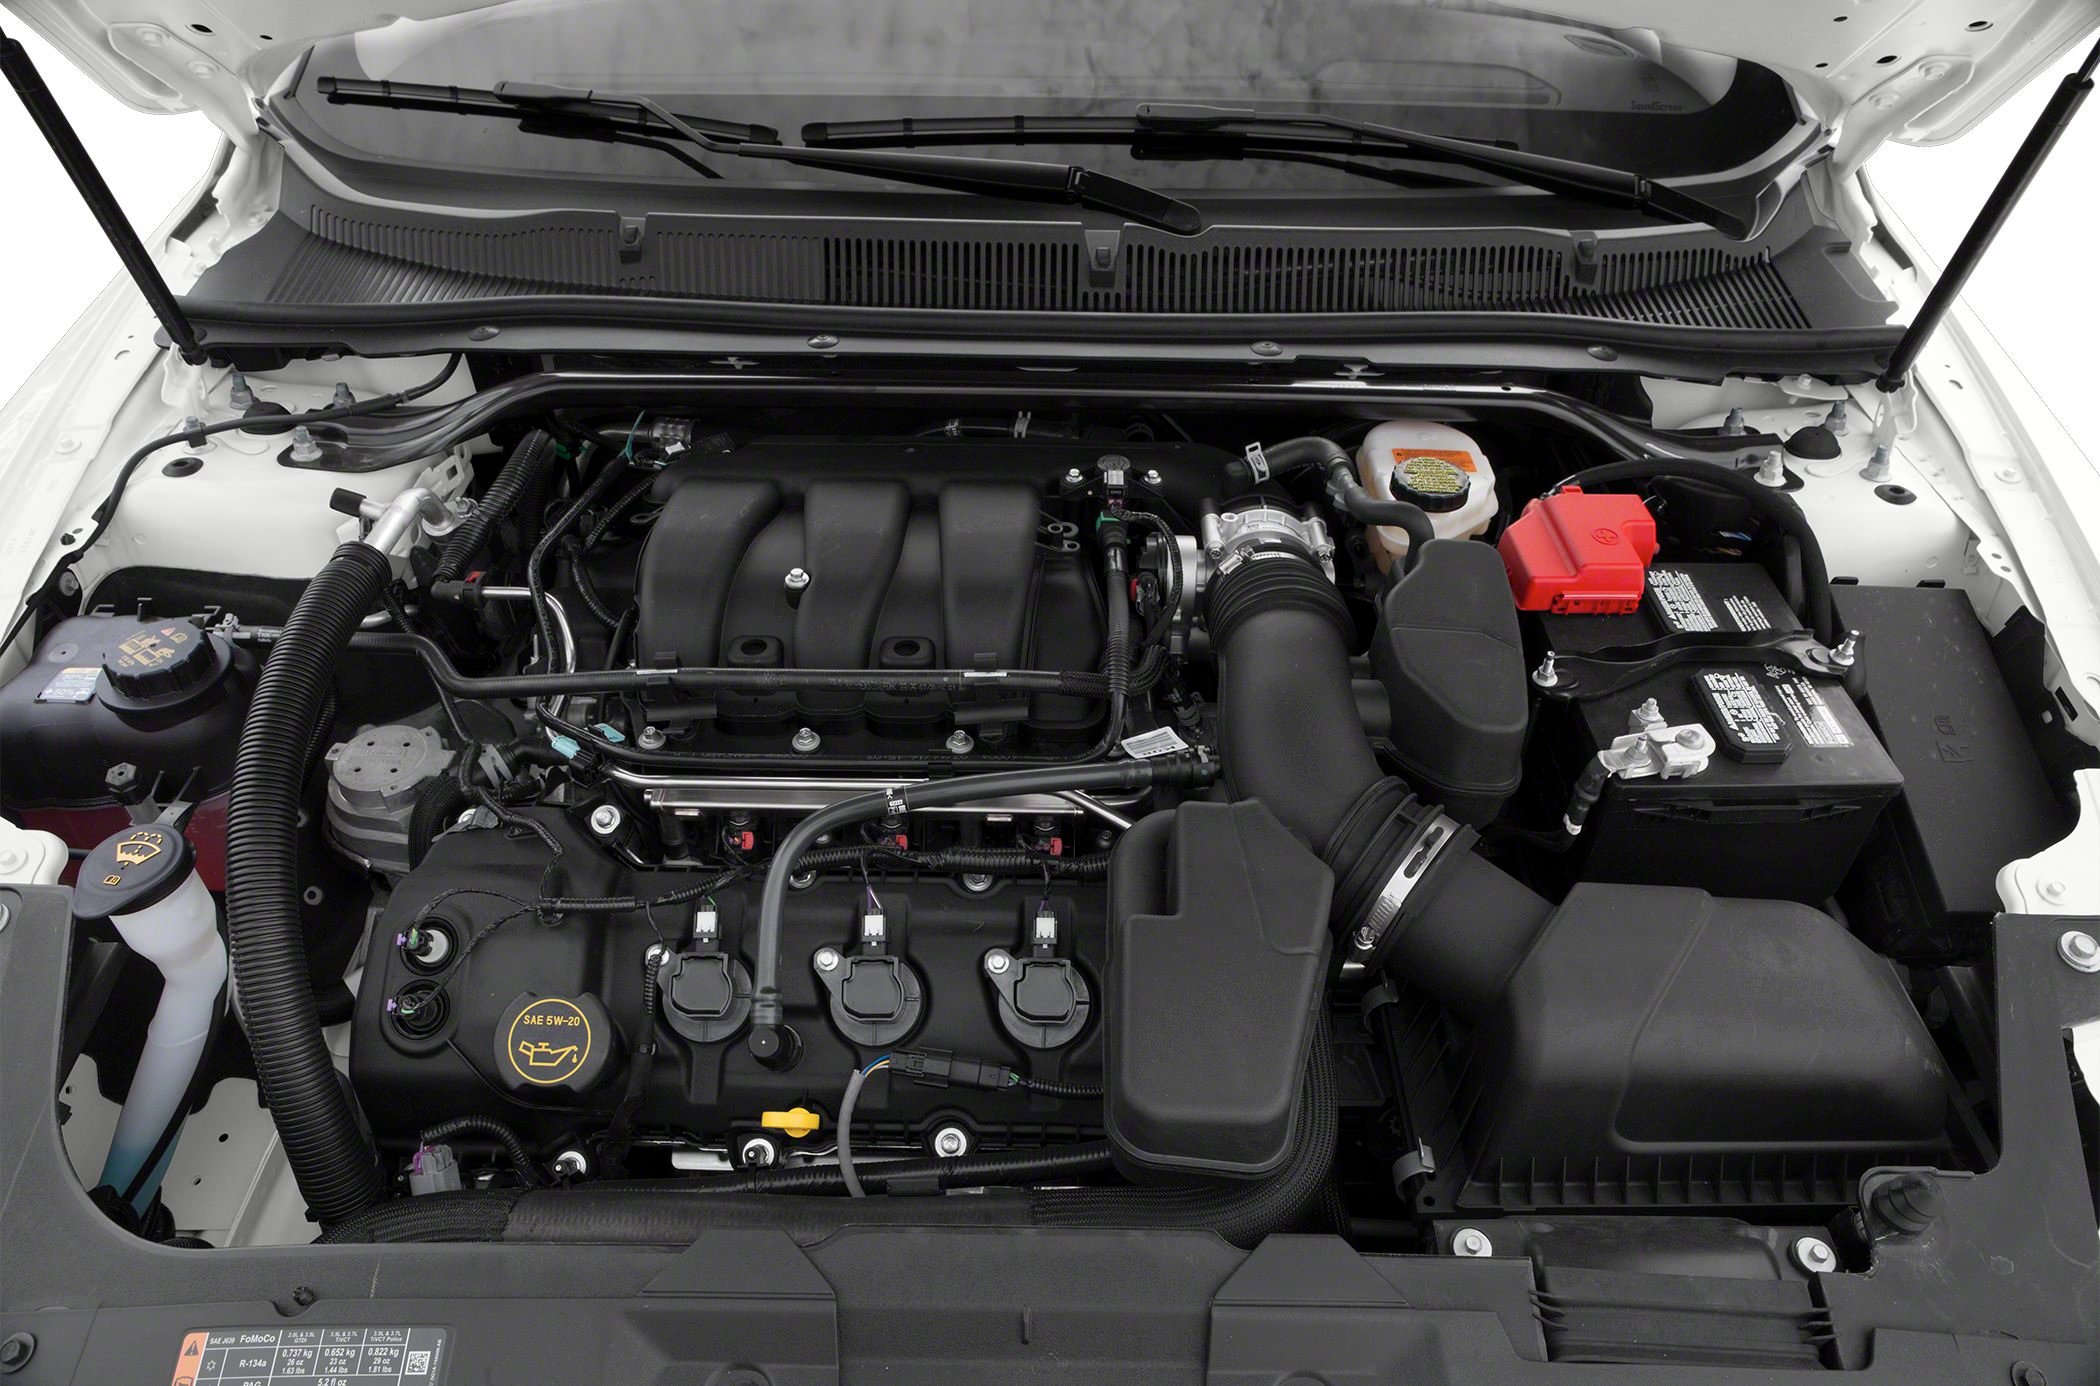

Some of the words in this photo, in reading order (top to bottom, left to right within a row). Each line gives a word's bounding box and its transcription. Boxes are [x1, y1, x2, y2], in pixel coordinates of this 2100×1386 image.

[523, 1015, 543, 1025] SAE
[546, 1016, 580, 1026] 5W-20
[240, 1334, 275, 1343] FoMoCo
[282, 1349, 302, 1357] 0.737
[303, 1349, 313, 1358] kg
[324, 1348, 344, 1356] 0.652
[346, 1348, 356, 1358] kg
[368, 1347, 388, 1356] 0.822
[389, 1347, 399, 1357] kg
[240, 1359, 267, 1367] R-134a
